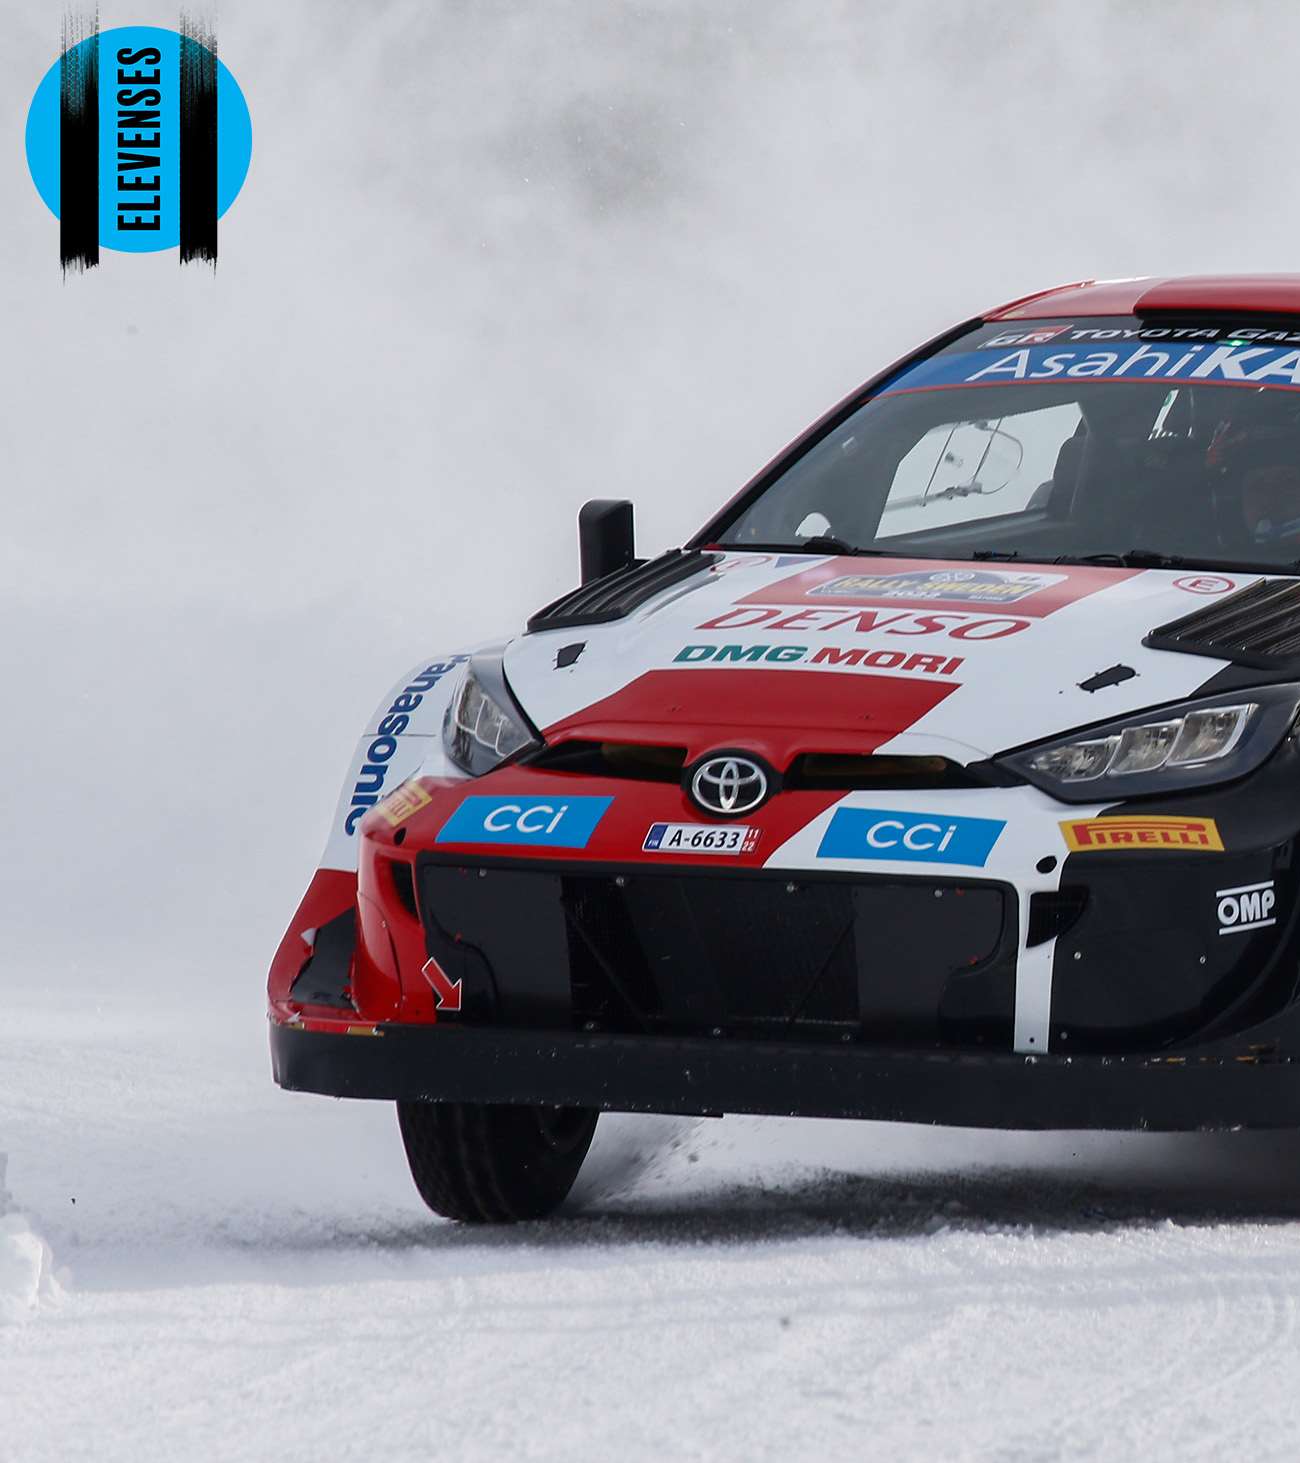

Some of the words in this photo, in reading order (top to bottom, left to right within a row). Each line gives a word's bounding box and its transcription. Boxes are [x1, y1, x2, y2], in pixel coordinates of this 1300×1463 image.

[1070, 328, 1221, 341] TOYOTA
[694, 607, 1032, 641] DENSO
[668, 829, 740, 849] A-6633
[1072, 821, 1210, 846] PIRELLI
[1217, 889, 1276, 926] OMP
